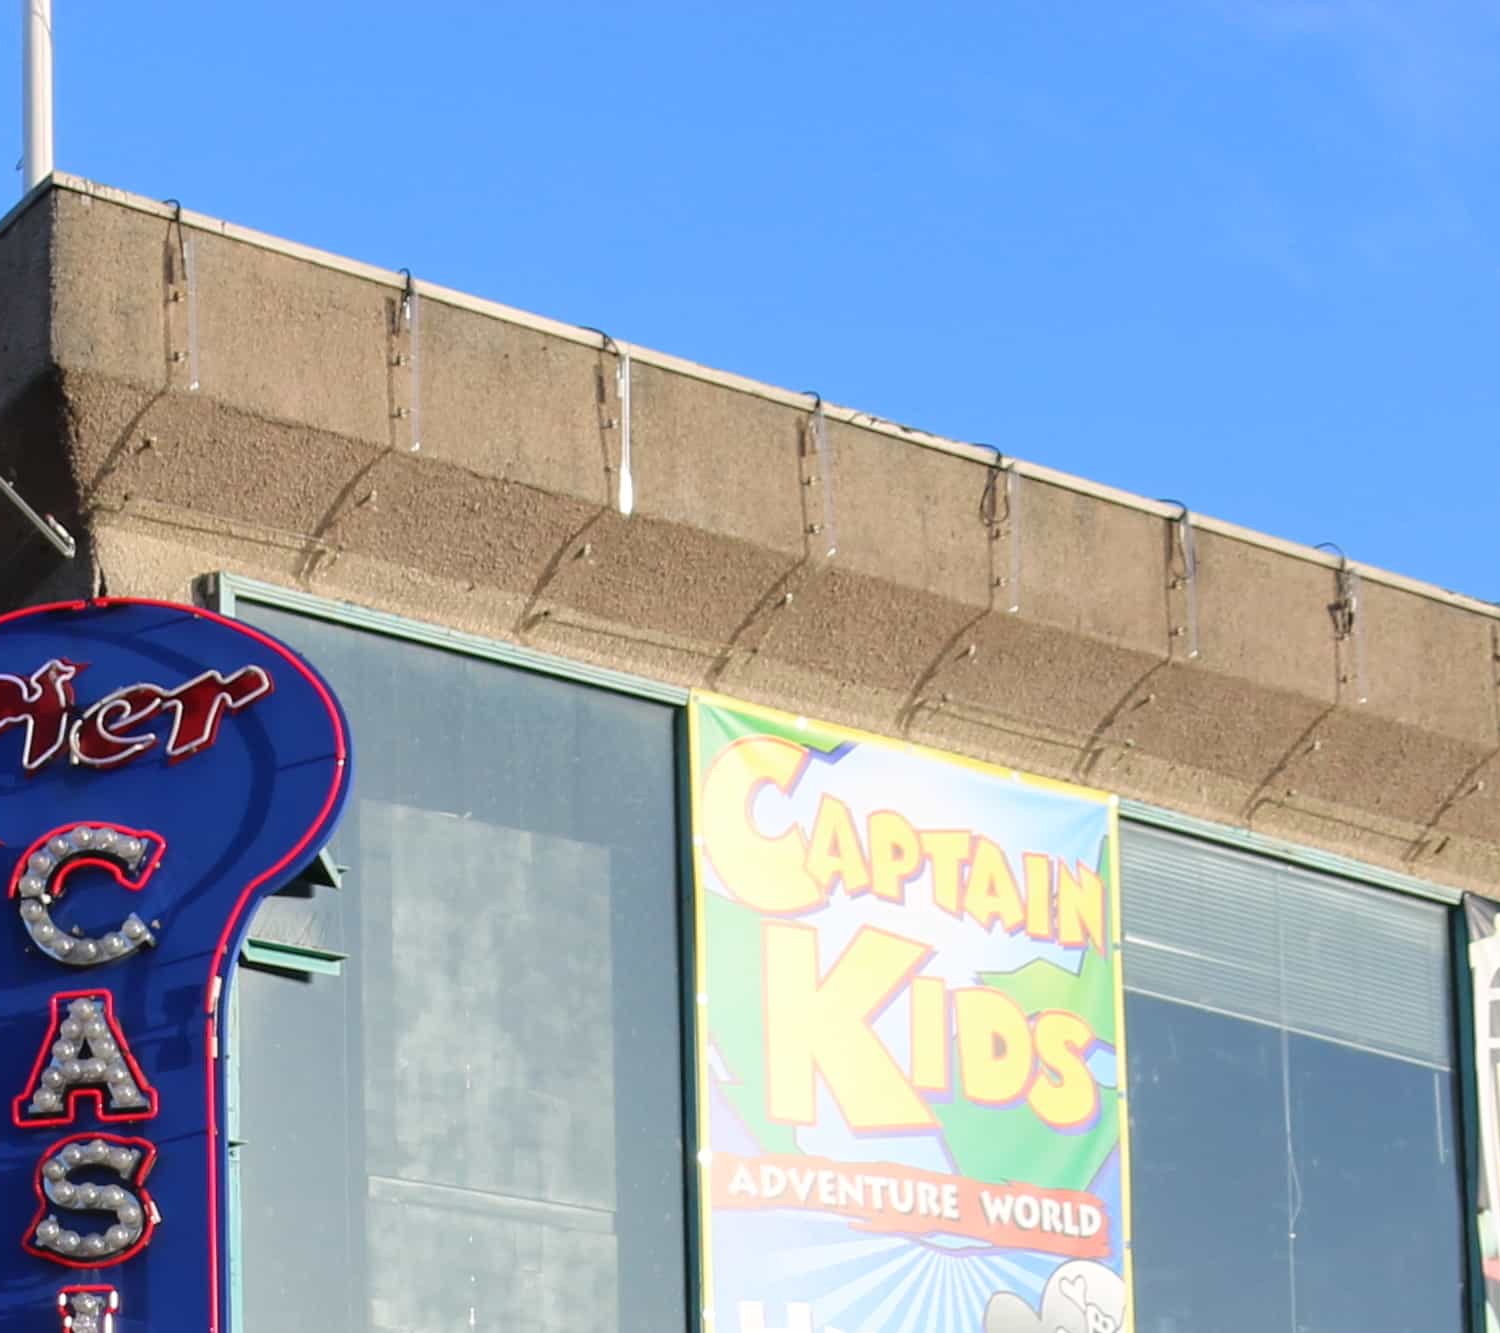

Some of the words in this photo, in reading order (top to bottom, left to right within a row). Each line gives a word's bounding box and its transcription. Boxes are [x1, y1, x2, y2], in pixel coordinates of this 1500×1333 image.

[702, 735, 1108, 958] CAPTAIN
[762, 919, 1102, 1133] KIDS
[727, 1162, 960, 1221] ADVENTURE
[980, 1191, 1101, 1239] WORLD
